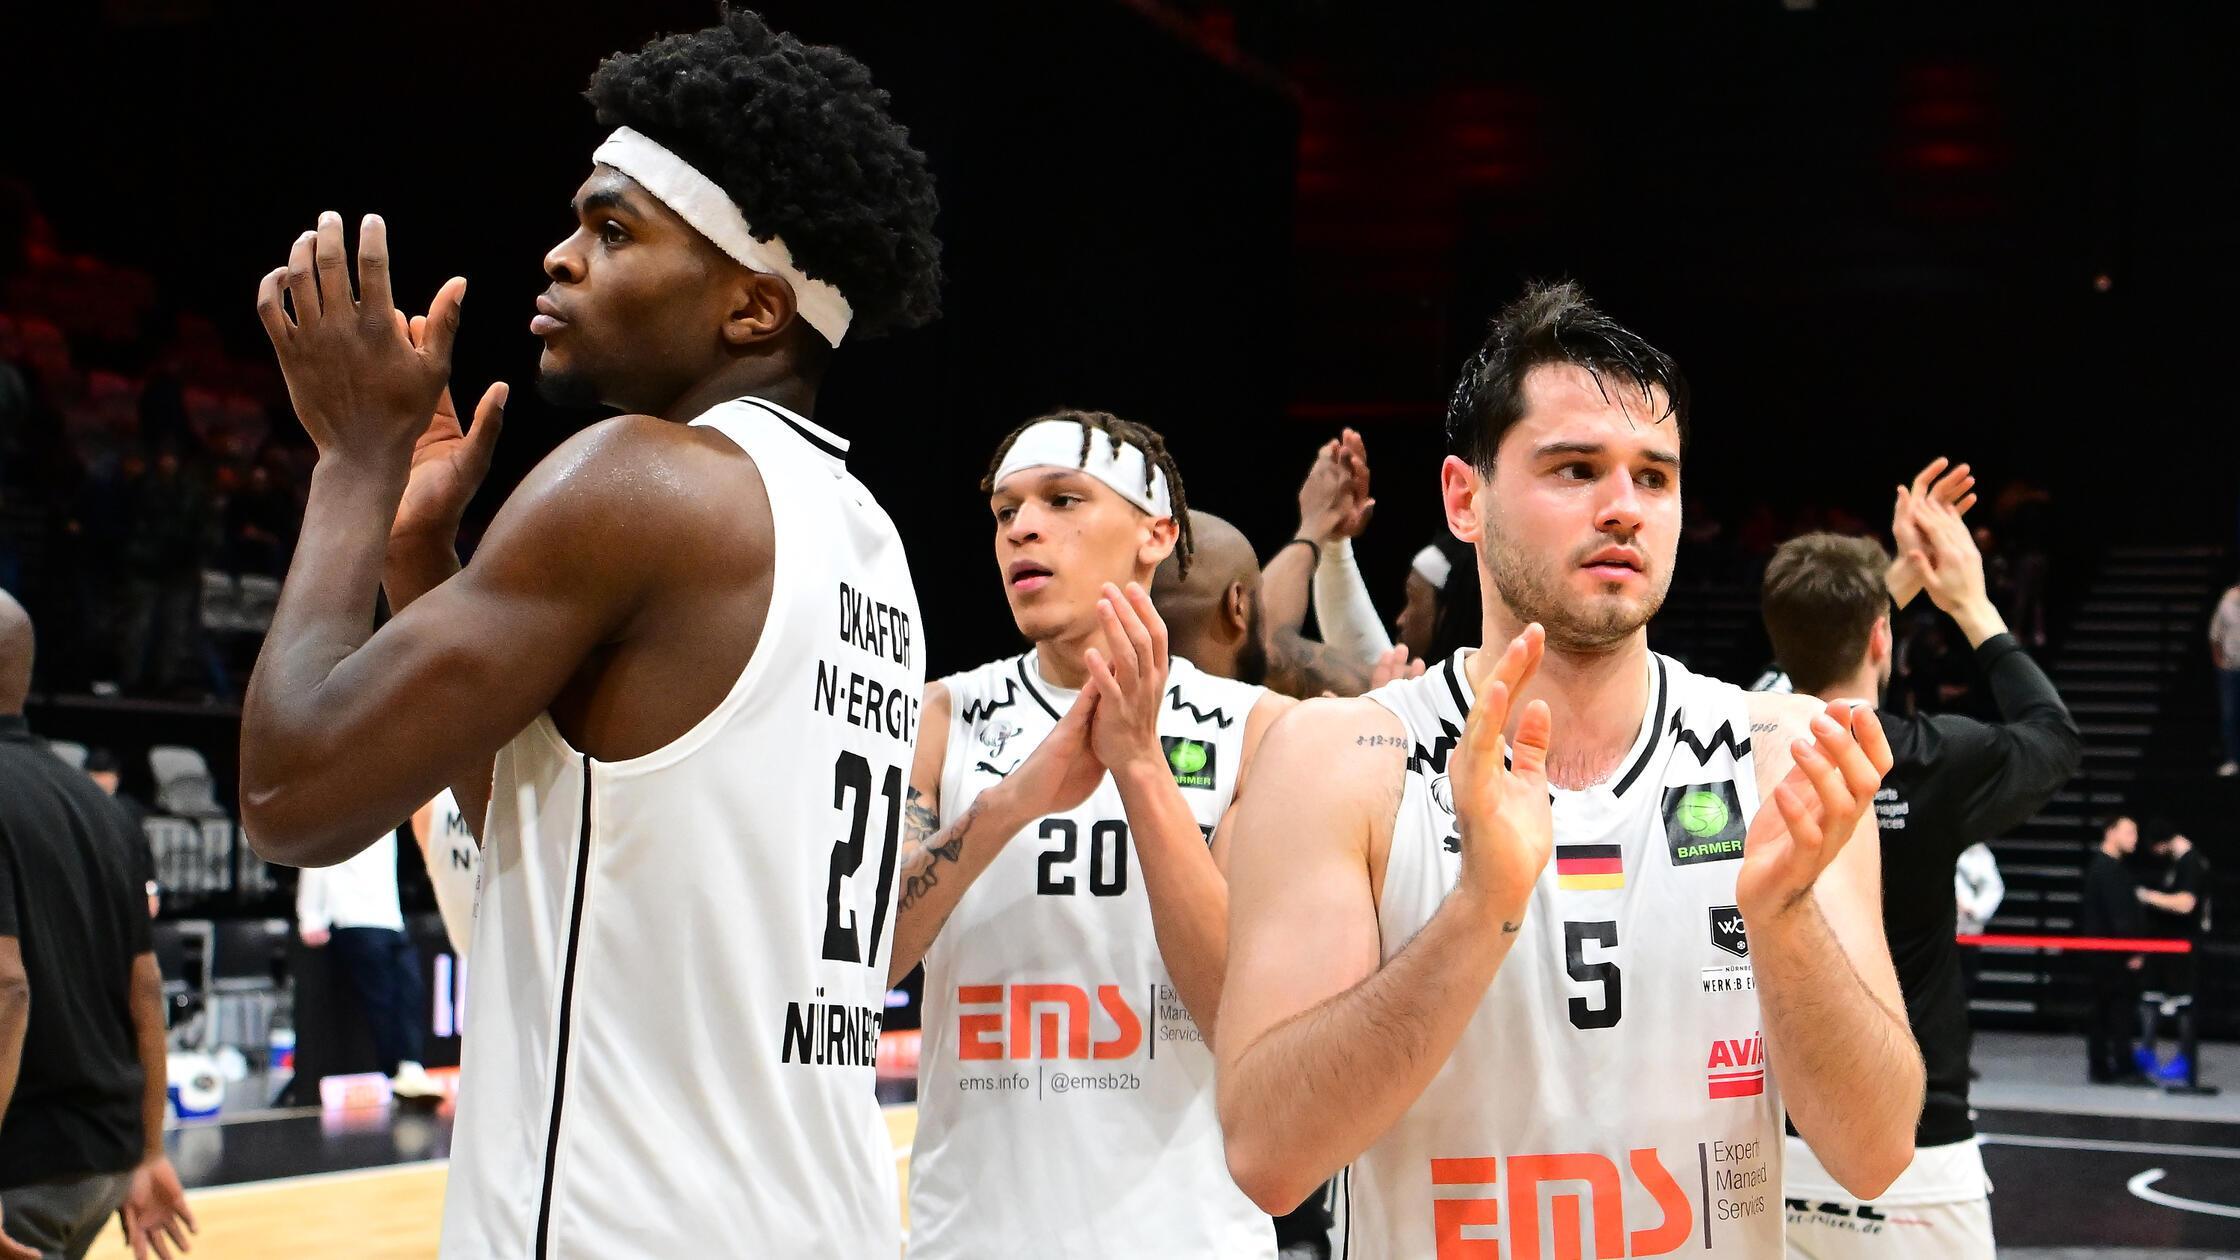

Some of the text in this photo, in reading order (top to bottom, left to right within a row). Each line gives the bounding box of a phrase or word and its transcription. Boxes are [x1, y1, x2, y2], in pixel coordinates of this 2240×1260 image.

[840, 581, 910, 670] OKAFOR
[1173, 774, 1211, 786] ARMER
[821, 749, 903, 969] 21
[1037, 818, 1129, 897] 20
[1677, 840, 1742, 859] BARMER
[1564, 920, 1622, 1031] 5
[958, 984, 1143, 1060] EMS
[959, 1072, 1140, 1093] ems.info @emsb2b
[1430, 1147, 1693, 1260] EMS
